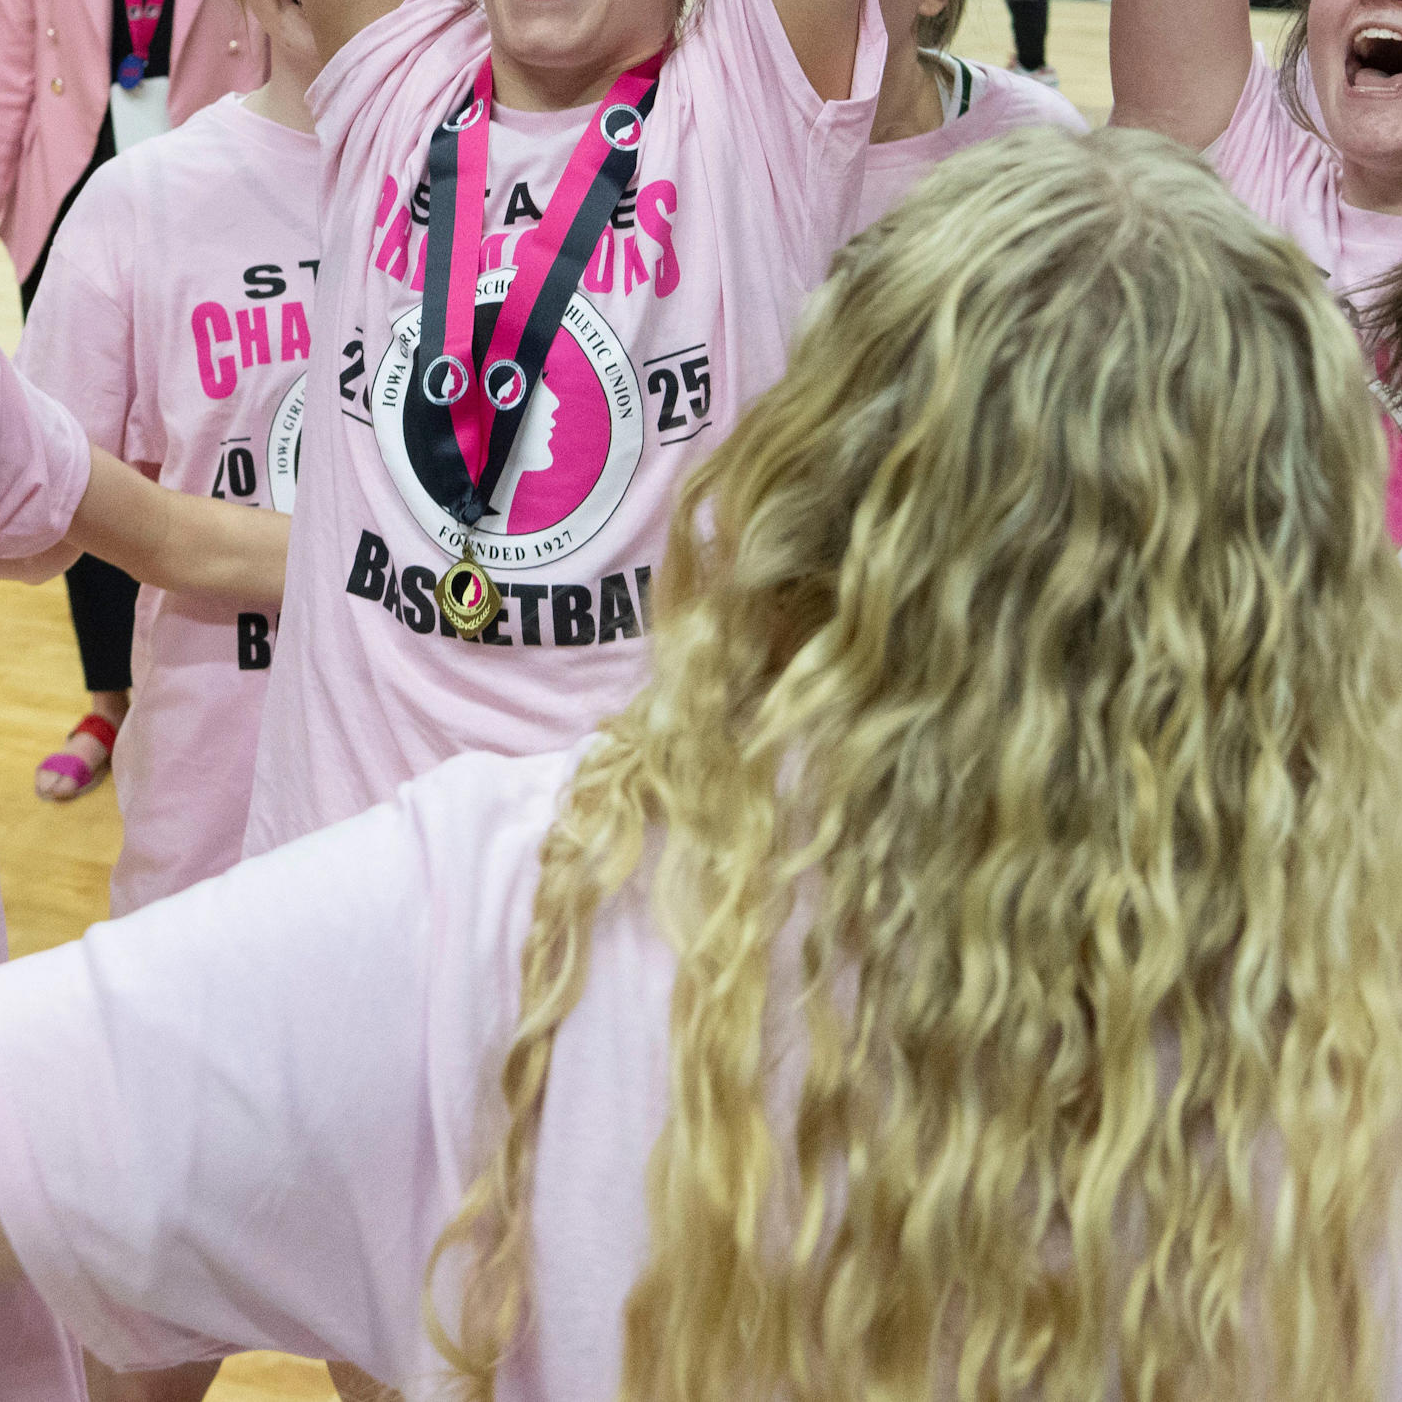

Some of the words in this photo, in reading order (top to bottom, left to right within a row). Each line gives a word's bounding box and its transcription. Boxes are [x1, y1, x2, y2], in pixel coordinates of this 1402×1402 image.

[382, 362, 407, 408] IOWA
[565, 305, 612, 360] HLETIC
[604, 358, 635, 421] UNION
[647, 356, 710, 432] 25
[533, 530, 575, 560] 1927
